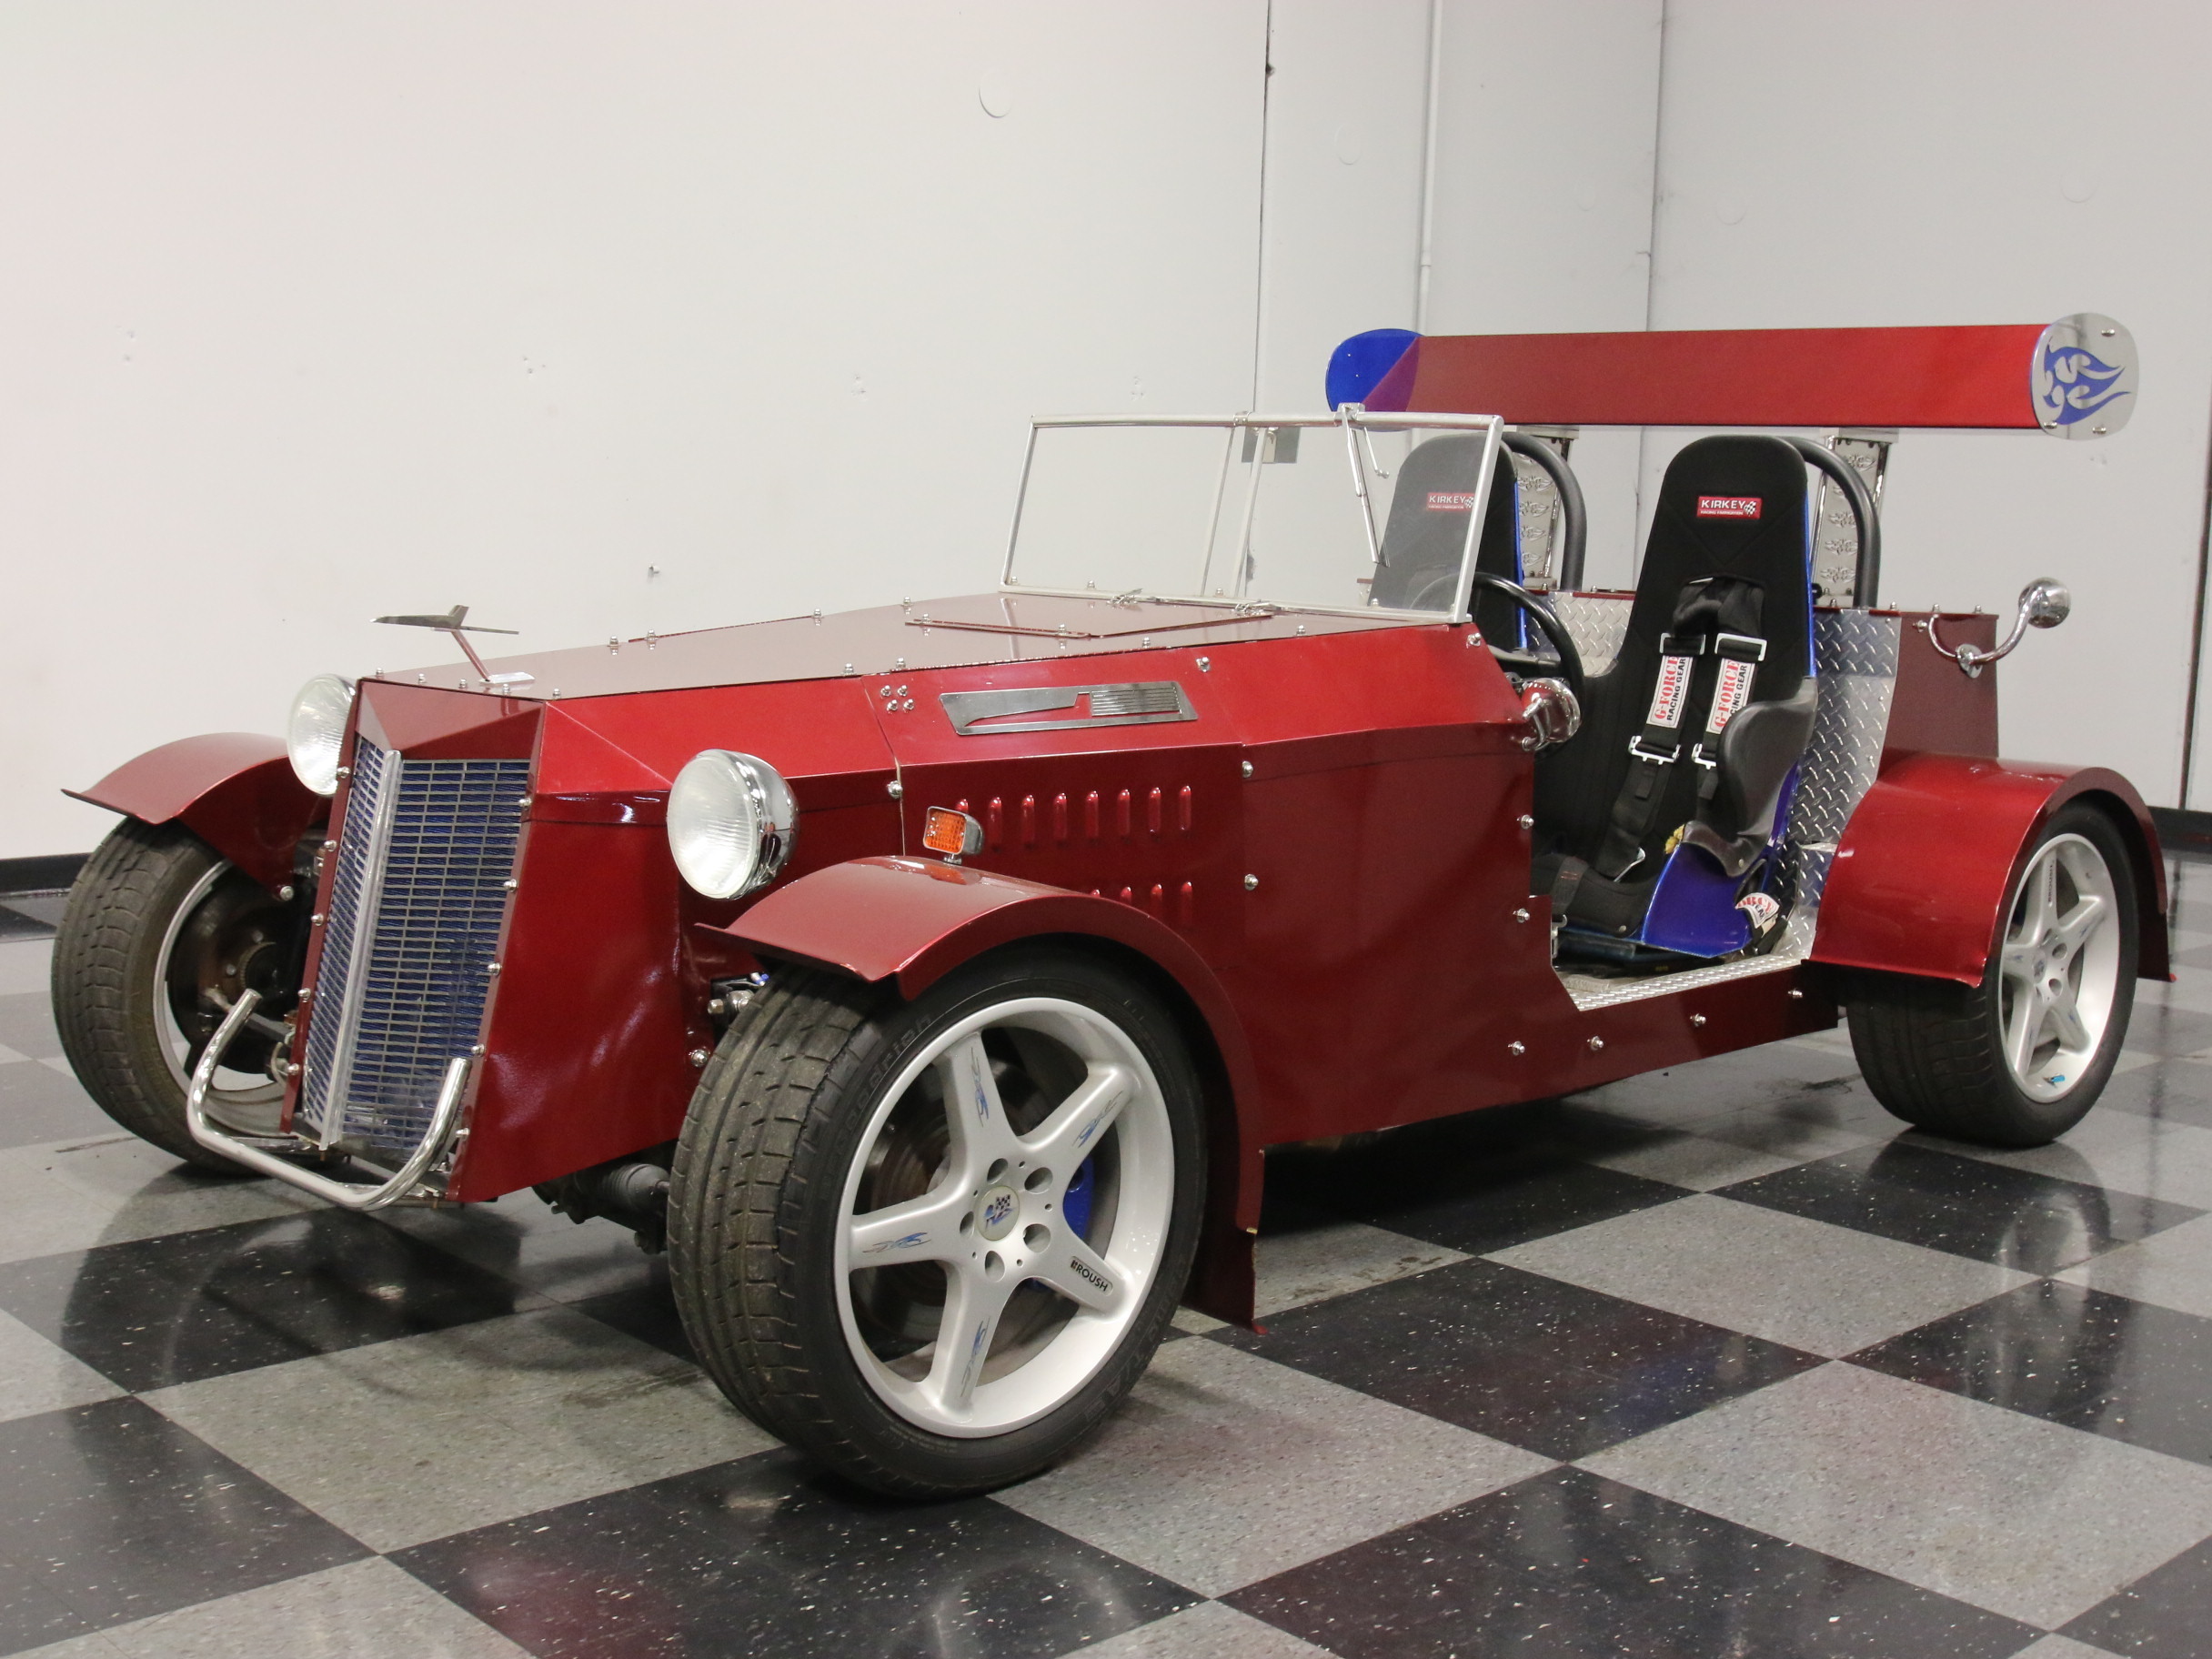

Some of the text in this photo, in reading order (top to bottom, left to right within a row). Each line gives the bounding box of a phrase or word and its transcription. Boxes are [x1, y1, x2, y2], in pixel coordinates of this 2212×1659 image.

[1429, 495, 1466, 504] KIRKEY
[1701, 499, 1746, 509] KIRKEY
[1654, 656, 1679, 719] G-FORCE
[1666, 658, 1686, 720] RACING GEAR
[1714, 660, 1740, 727] G-FORCE
[1730, 665, 1748, 716] CING GEAR
[1075, 1263, 1109, 1292] ROUSH
